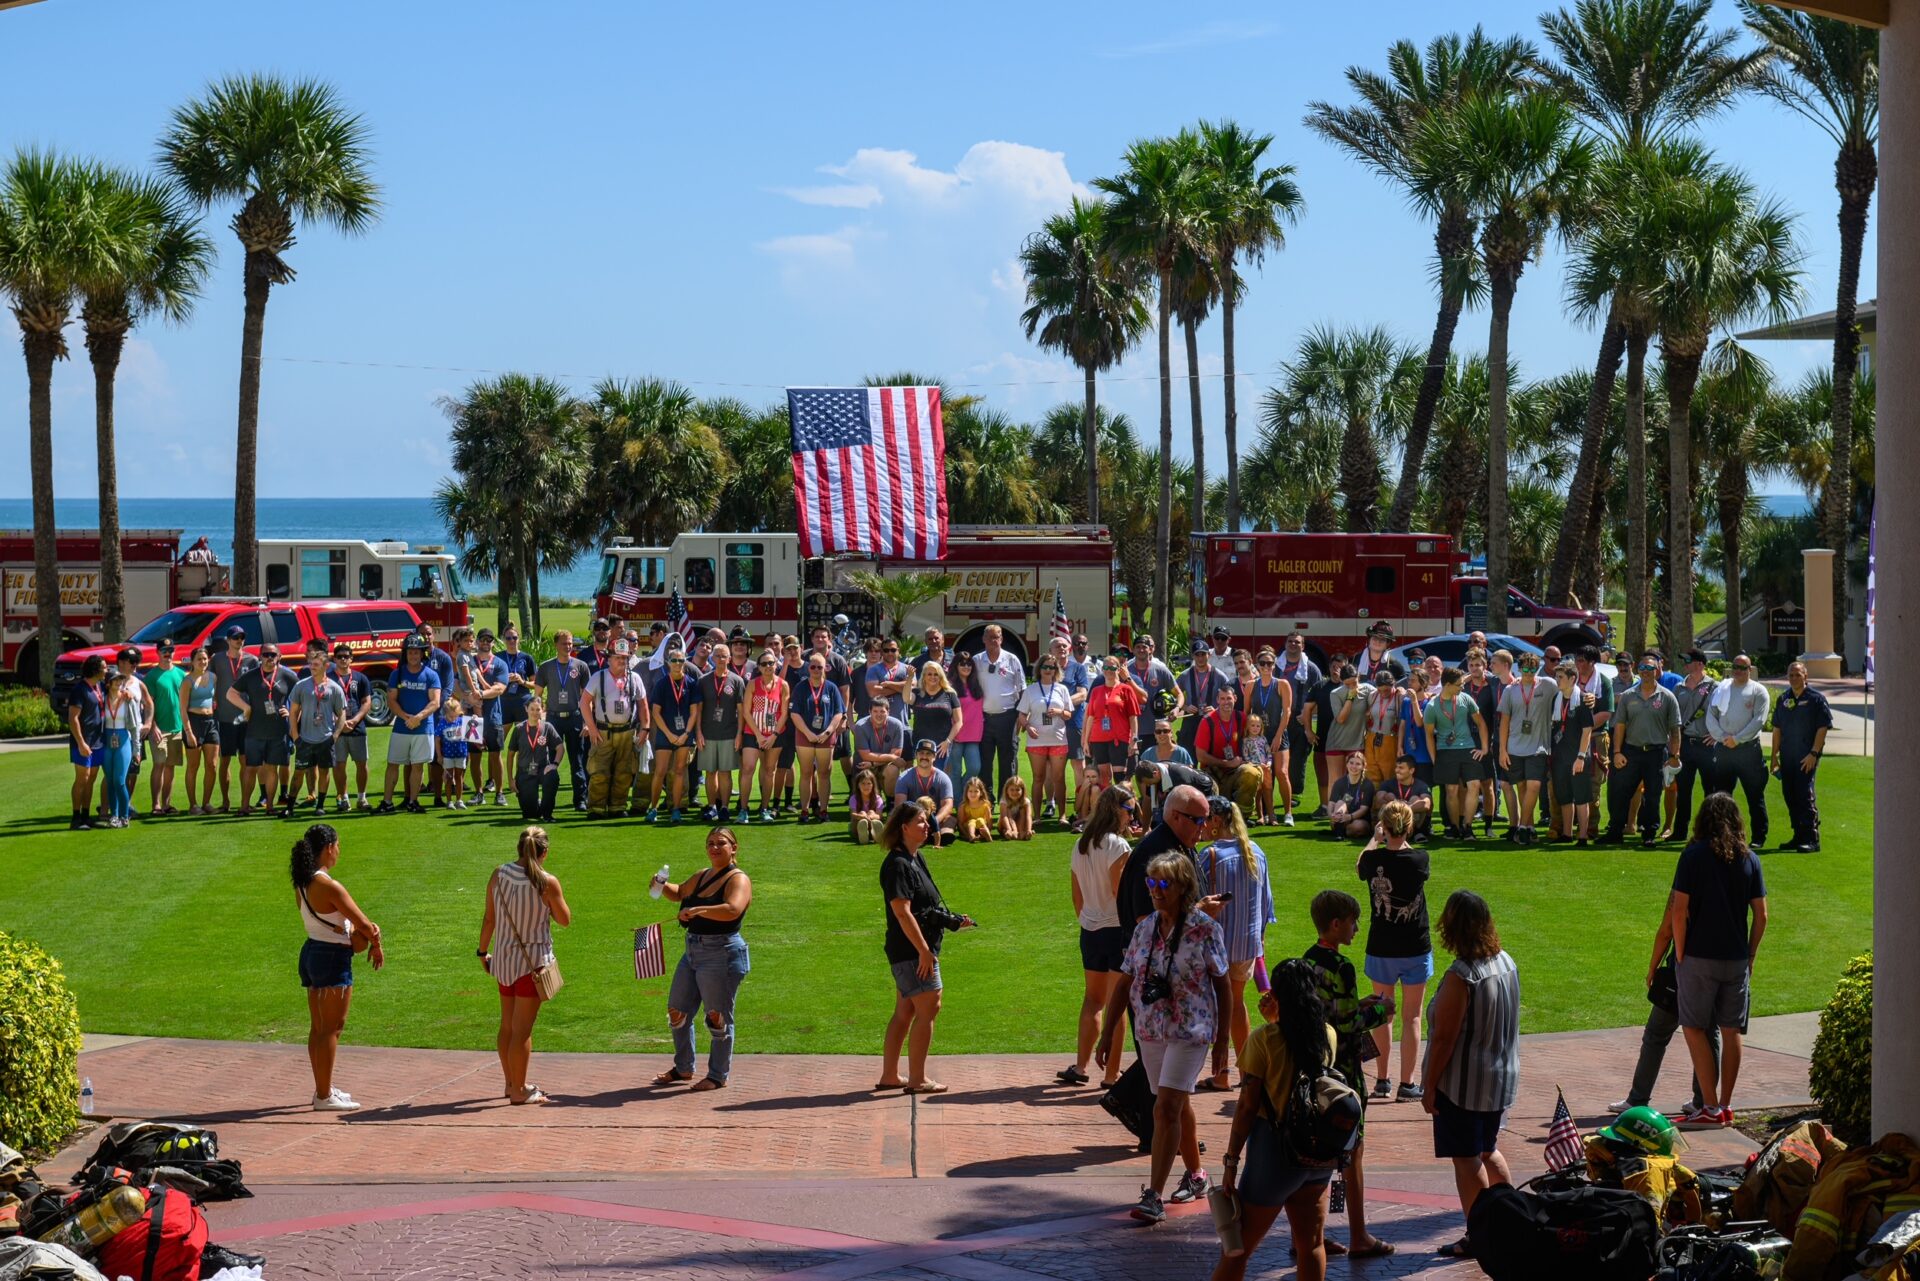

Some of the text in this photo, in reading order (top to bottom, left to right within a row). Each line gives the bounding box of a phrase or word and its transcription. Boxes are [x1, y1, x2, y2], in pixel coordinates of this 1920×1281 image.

[1268, 560, 1343, 573] FLAGLER COUNTY
[29, 573, 98, 588] CNTY
[966, 572, 1030, 586] COUNTY
[1421, 573, 1434, 584] 41
[1279, 580, 1334, 593] FIRE RESCUE
[14, 590, 104, 605] FIR RESC
[954, 588, 1056, 603] FIRE RESCUE
[1066, 618, 1087, 634] 911
[375, 638, 404, 648] COUN
